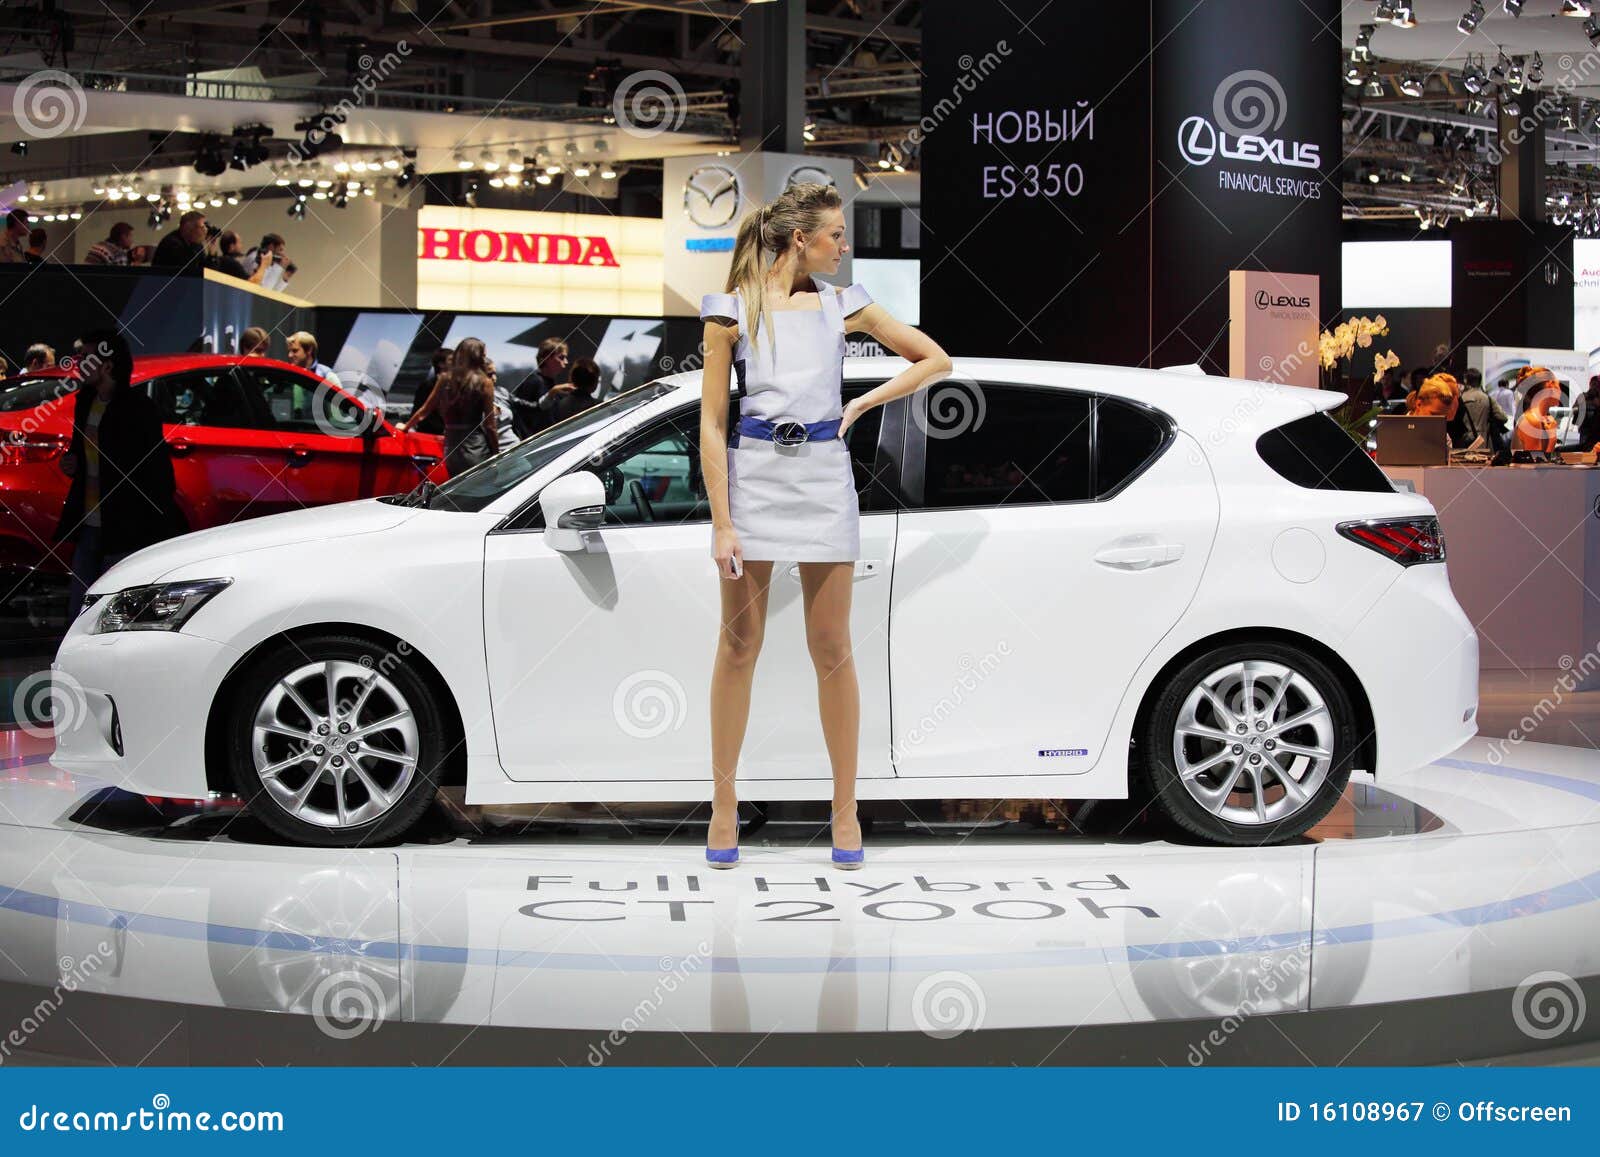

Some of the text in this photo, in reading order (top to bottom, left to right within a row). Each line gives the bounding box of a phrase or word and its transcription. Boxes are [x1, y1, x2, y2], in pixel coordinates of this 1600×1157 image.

[973, 101, 1094, 144] НОВЫЙ
[1219, 131, 1321, 169] LEXUS
[983, 163, 1084, 198] ES 350
[1219, 170, 1321, 199] FINANCIAL SERVICES
[417, 227, 620, 267] HONDA
[1270, 295, 1311, 308] LEXUS
[526, 874, 1131, 897] Full Hybrid
[518, 897, 1162, 922] CT 200h
